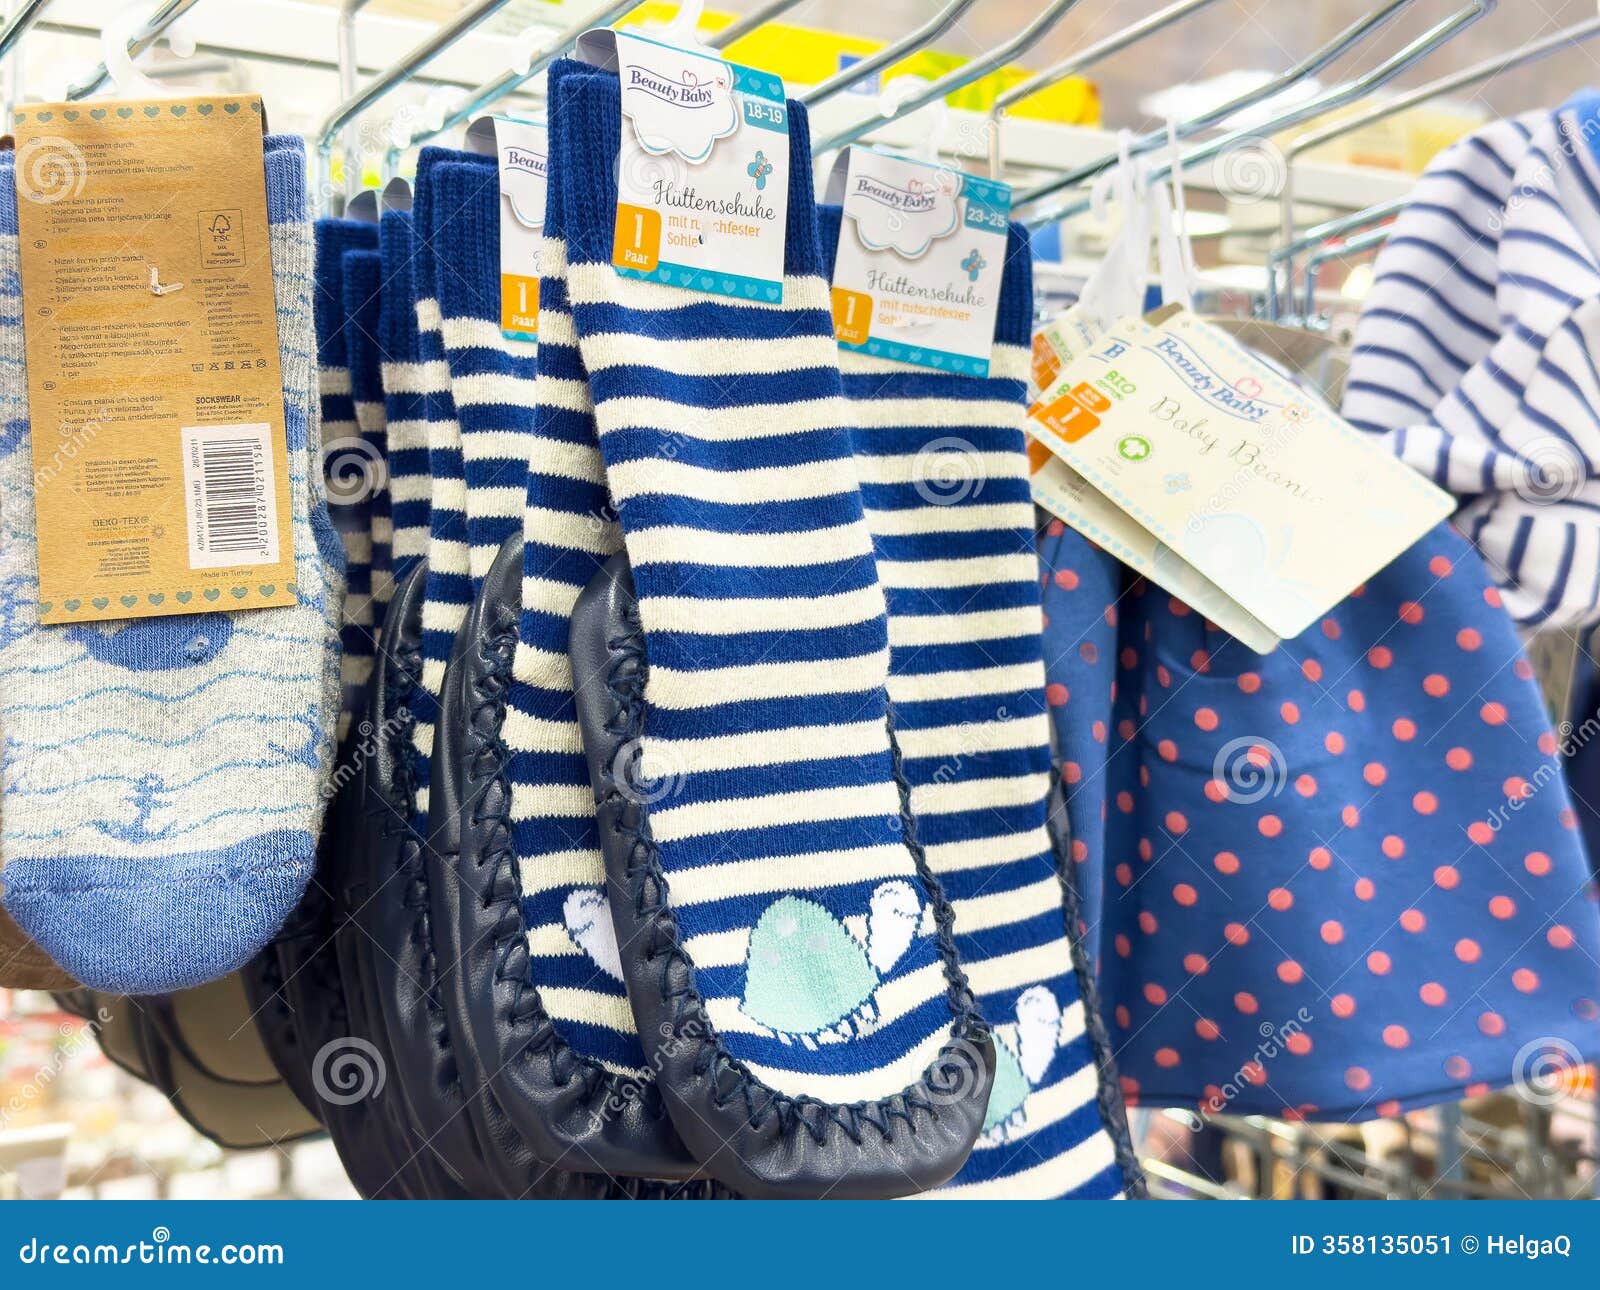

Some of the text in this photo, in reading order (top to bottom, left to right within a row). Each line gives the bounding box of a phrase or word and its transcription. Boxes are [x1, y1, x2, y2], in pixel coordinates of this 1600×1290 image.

[631, 70, 712, 103] Beauty Baby
[748, 103, 783, 124] 18-19
[508, 151, 548, 171] Beau
[653, 179, 776, 220] Hüttenschuhe
[857, 179, 936, 208] Beauty Baby
[668, 215, 688, 230] mit
[968, 208, 1006, 228] 23-25
[633, 213, 642, 248] 1
[667, 232, 699, 248] Sohle
[624, 249, 649, 266] Paar
[517, 281, 526, 313] 1
[511, 315, 536, 328] Paar
[846, 295, 856, 325] 1
[878, 313, 902, 326] Soh
[1105, 370, 1137, 394] BIO
[1155, 338, 1269, 420] Beauty Baby
[195, 395, 241, 404] SOCKSWEAR
[1150, 396, 1219, 455] Baby
[253, 443, 265, 490] 021158
[256, 498, 269, 544] 200287
[200, 570, 219, 579] Made
